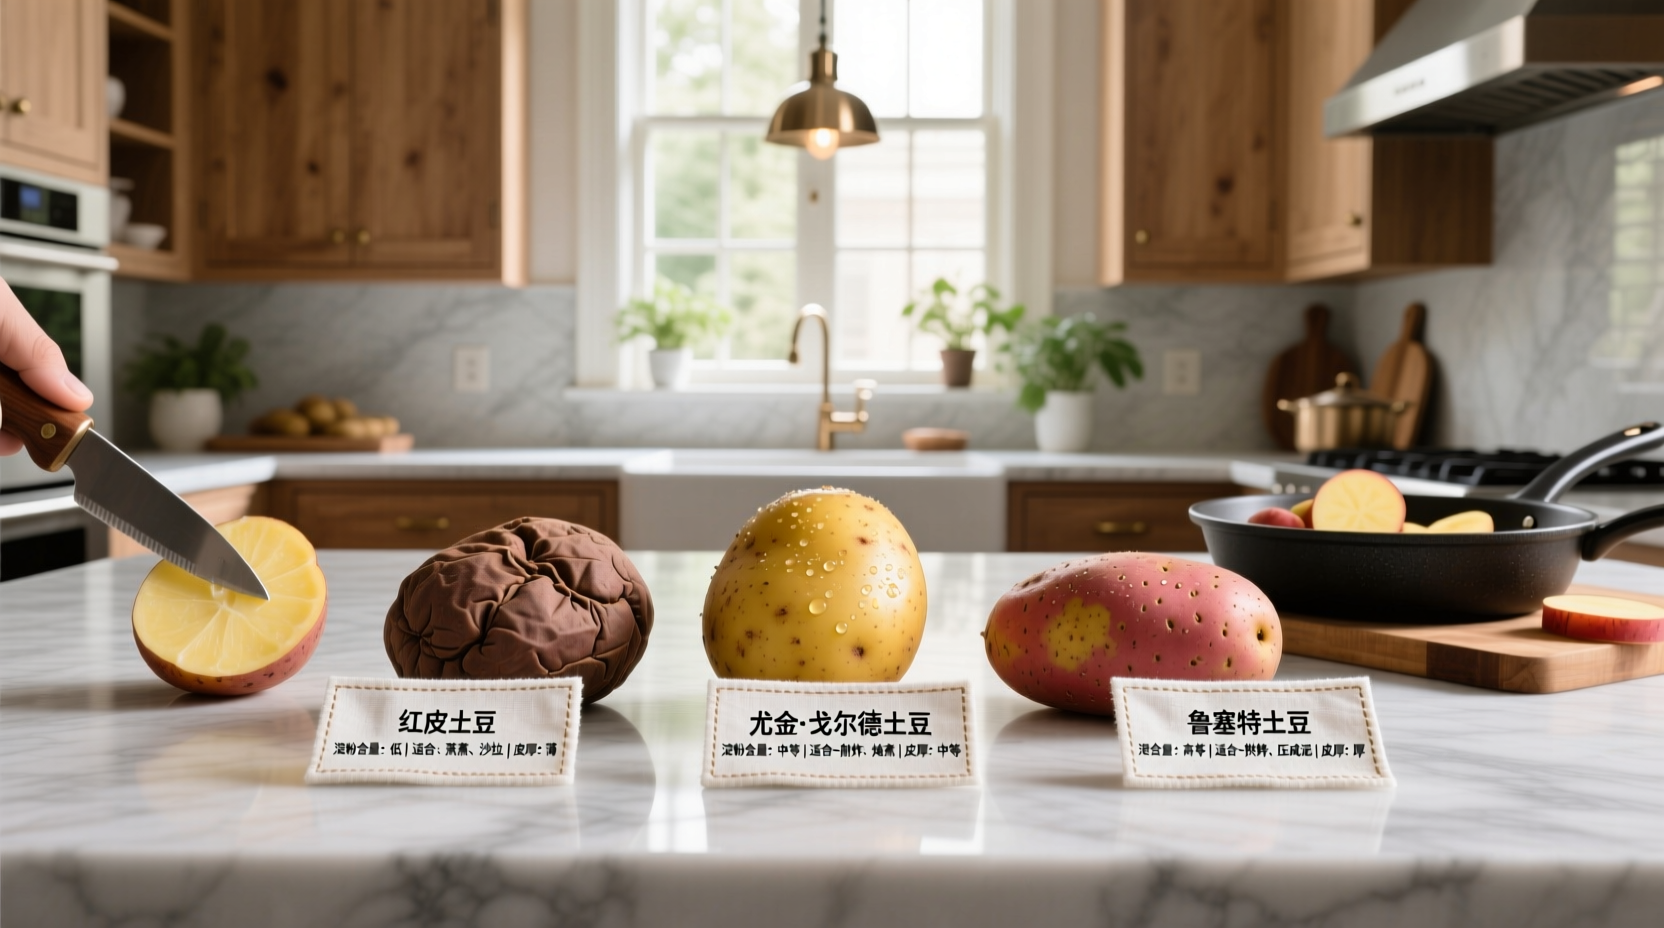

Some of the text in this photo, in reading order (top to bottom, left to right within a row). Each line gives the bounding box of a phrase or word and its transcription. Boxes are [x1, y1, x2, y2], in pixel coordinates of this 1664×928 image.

[398, 708, 497, 735] 红皮土豆
[749, 708, 932, 737] 尤金·戈尔德土豆
[1186, 709, 1312, 735] 鲁塞特土豆
